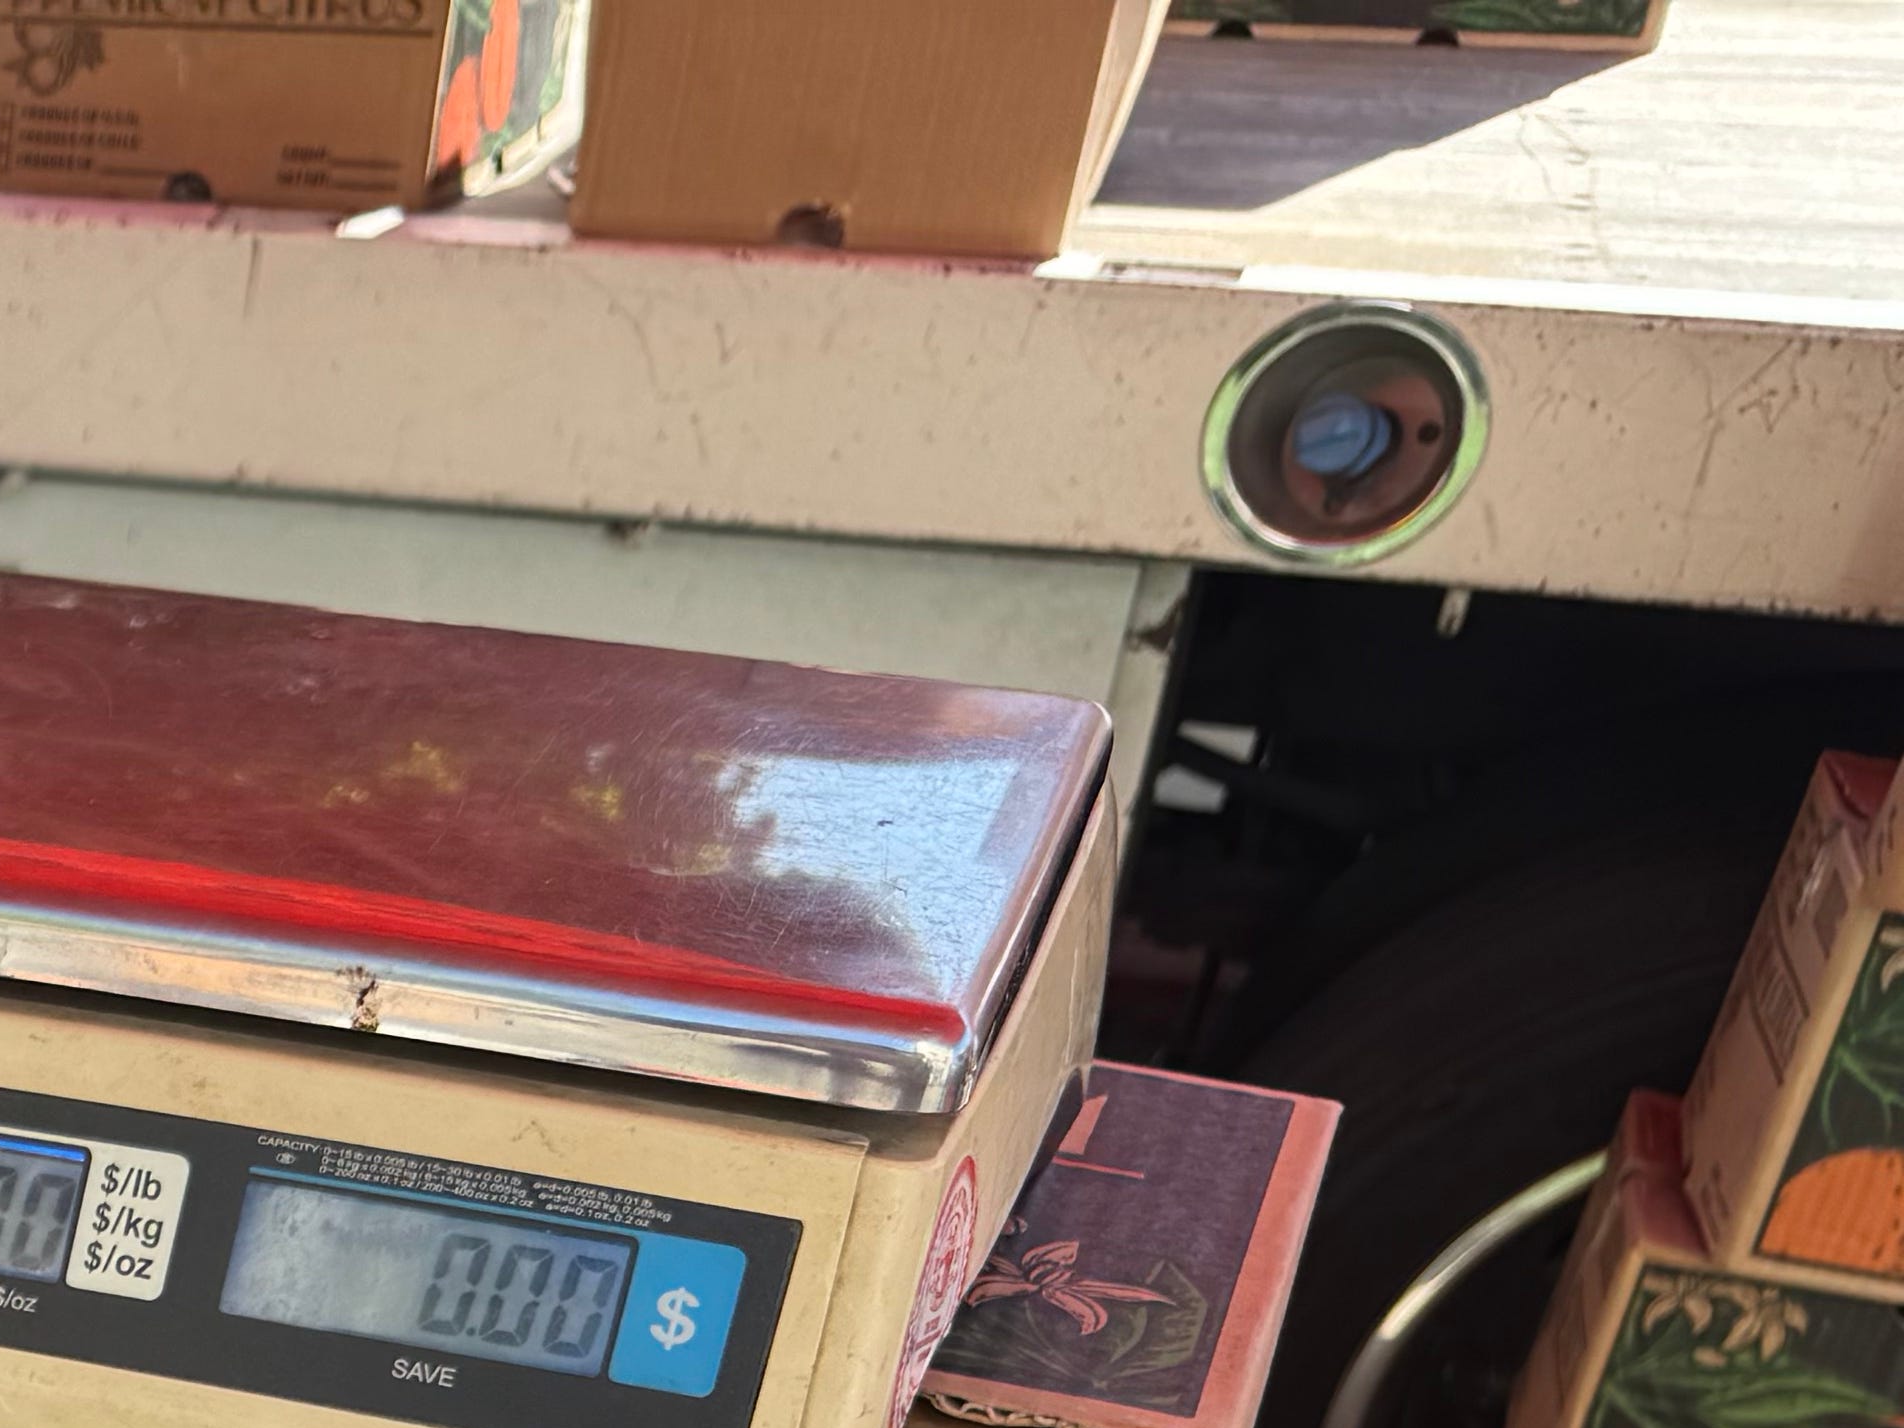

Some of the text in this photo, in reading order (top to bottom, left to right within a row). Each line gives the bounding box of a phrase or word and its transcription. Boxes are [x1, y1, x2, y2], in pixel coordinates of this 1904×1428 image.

[100, 1161, 162, 1201] $/lb
[92, 1201, 164, 1249] $/kg
[83, 1240, 155, 1282] $/oz
[417, 1232, 618, 1358] 0.00
[649, 1286, 701, 1351] $
[391, 1357, 458, 1389] SAVE
